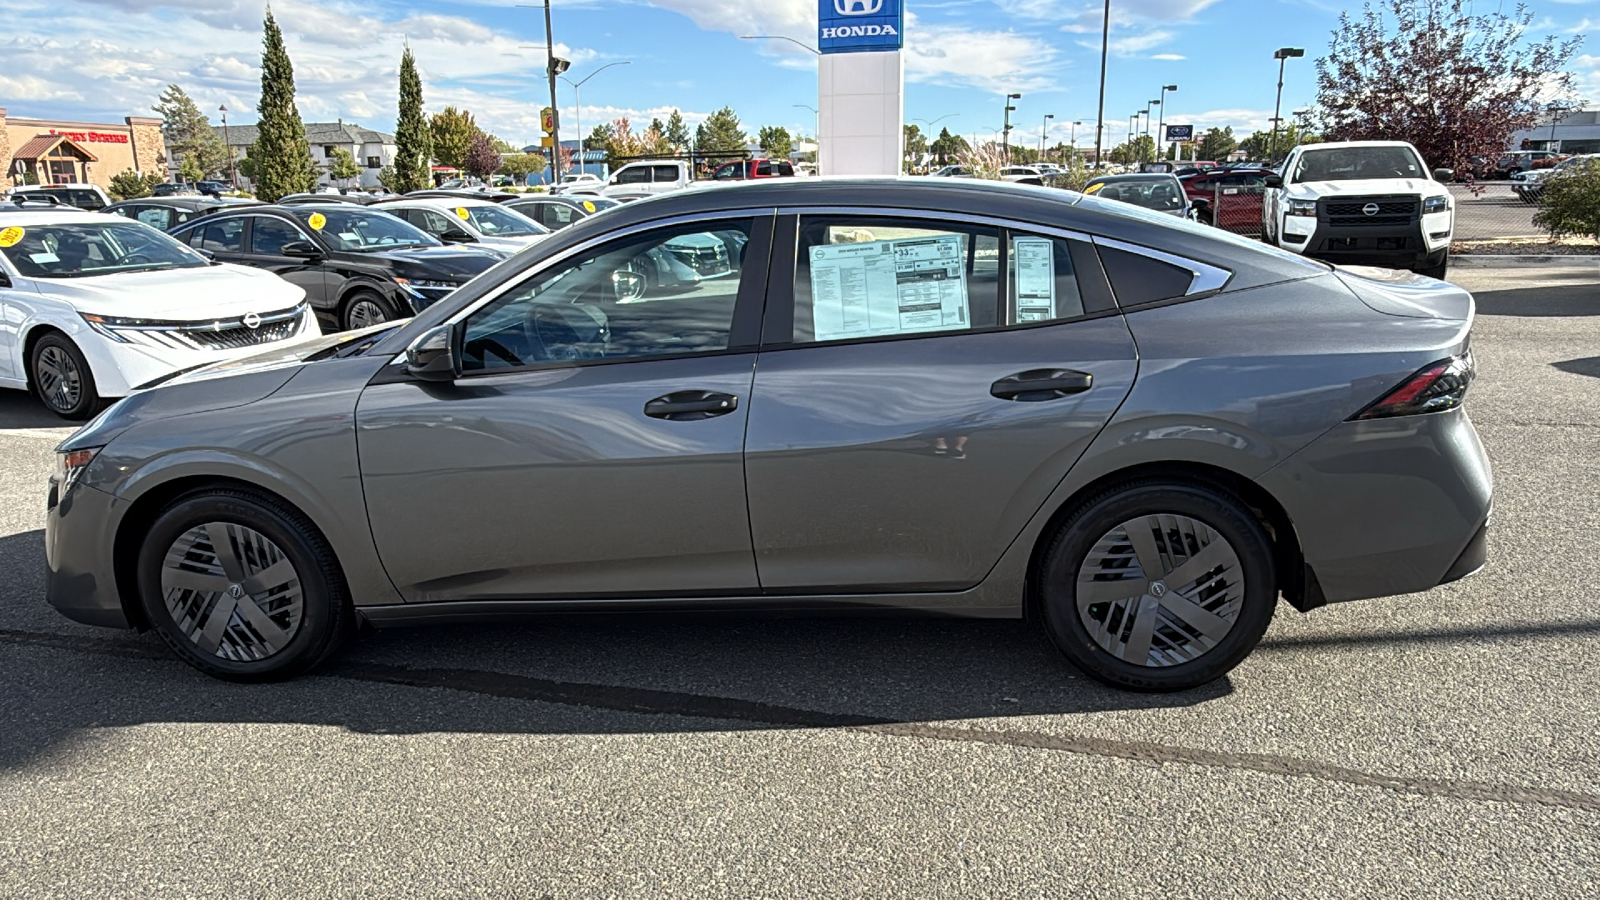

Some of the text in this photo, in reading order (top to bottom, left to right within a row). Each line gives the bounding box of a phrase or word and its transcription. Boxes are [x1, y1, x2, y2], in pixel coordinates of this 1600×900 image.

[821, 25, 898, 39] HONDA
[88, 132, 128, 143] STRIKE
[899, 249, 909, 257] 33
